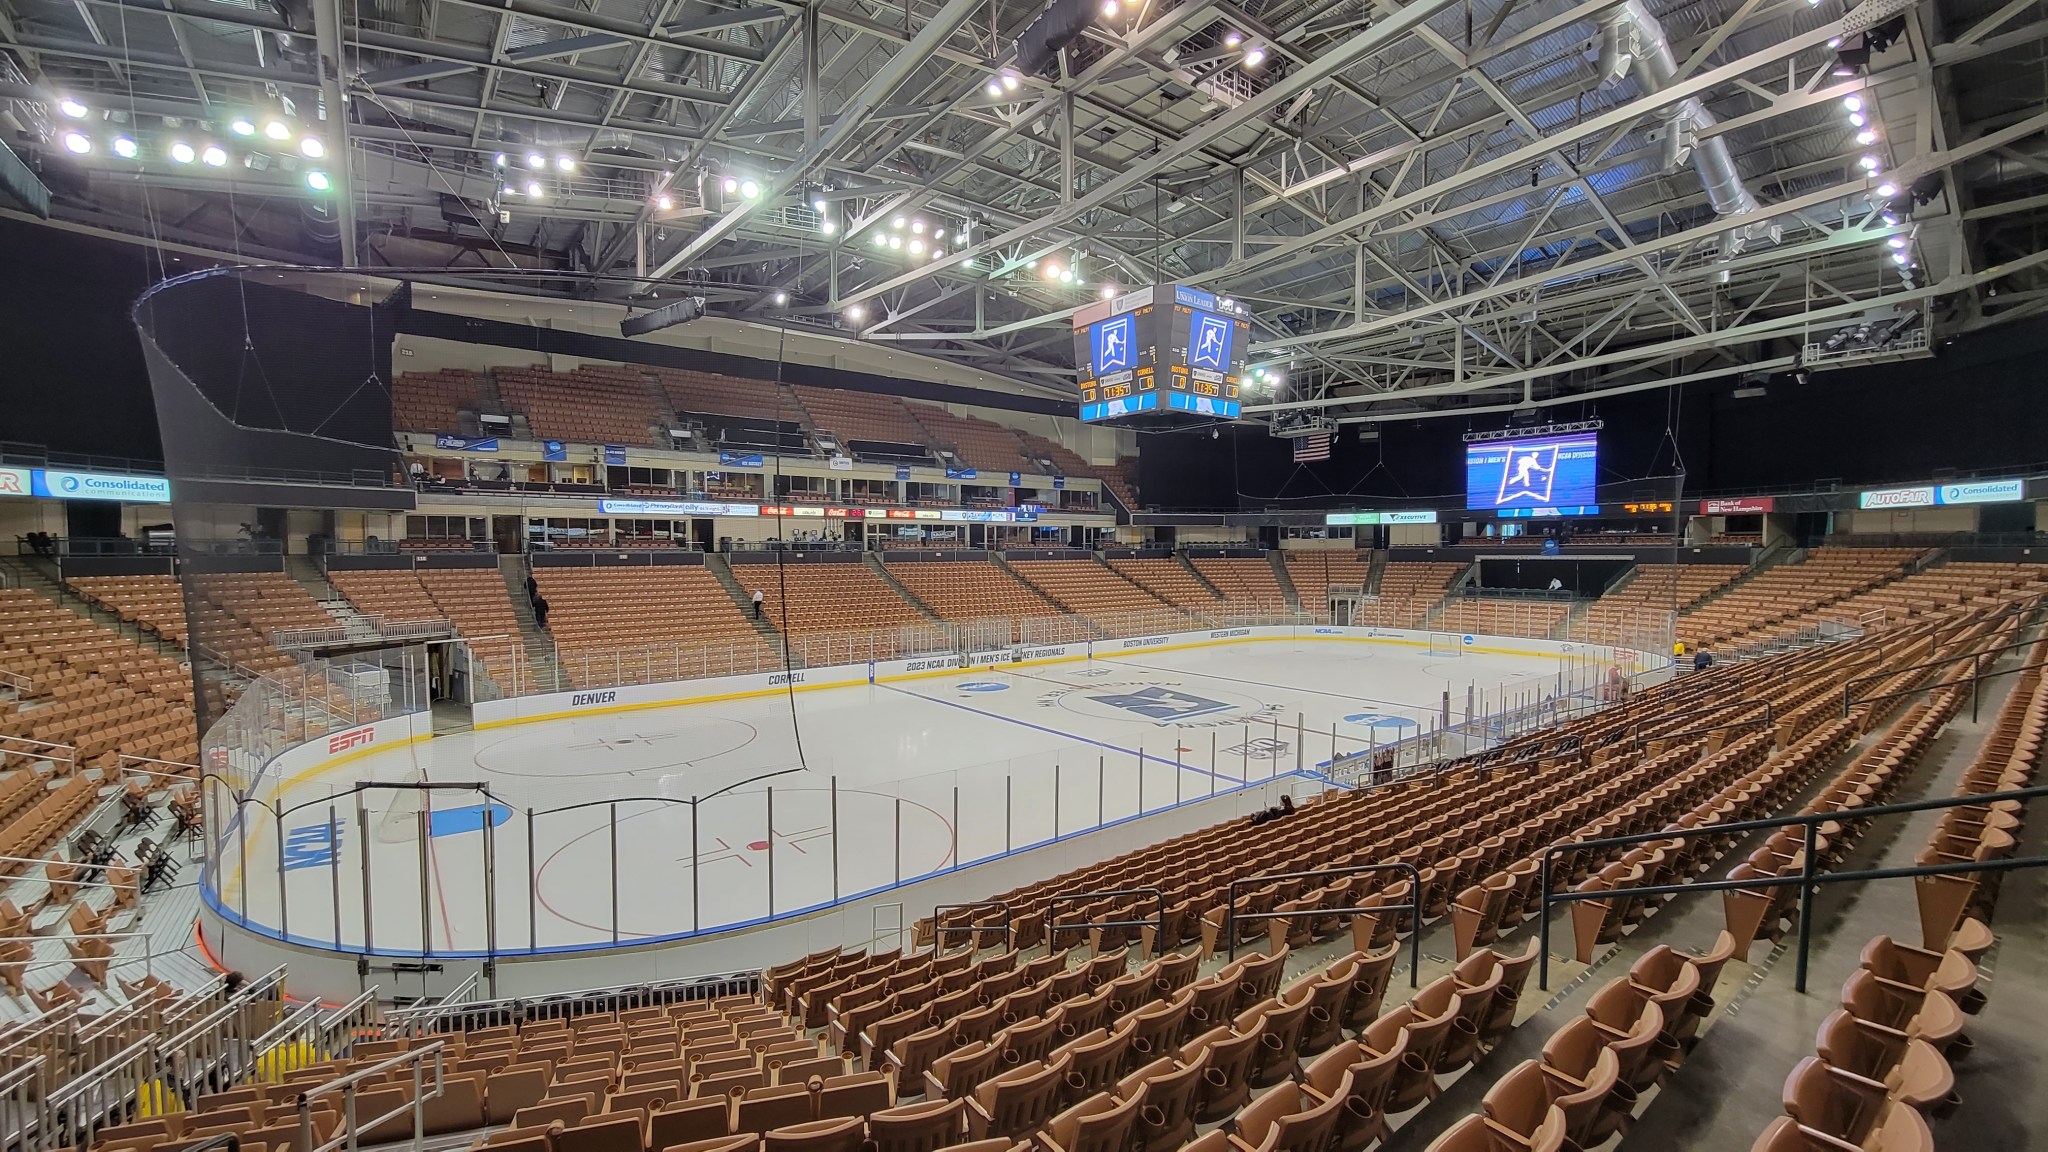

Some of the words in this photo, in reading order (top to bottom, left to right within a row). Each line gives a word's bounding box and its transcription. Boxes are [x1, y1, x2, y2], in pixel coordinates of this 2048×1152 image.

[1176, 290, 1193, 303] UNION
[1193, 295, 1214, 309] LEADER
[85, 478, 165, 491] Consolidated
[1963, 483, 2018, 495] Consolidated
[1210, 630, 1229, 639] WESTERN
[1230, 628, 1250, 638] MICHIGAN
[1123, 638, 1142, 649] BOSTON
[1143, 636, 1170, 647] UNIVERSITY
[906, 661, 926, 672] 2023
[926, 659, 945, 670] NCAA
[979, 652, 1001, 664] MEN'S
[1000, 651, 1011, 662] ICE
[1034, 647, 1065, 658] REGIONALS
[768, 672, 805, 686] CORNELL
[572, 691, 616, 707] DENVER
[329, 727, 375, 755] ESPN
